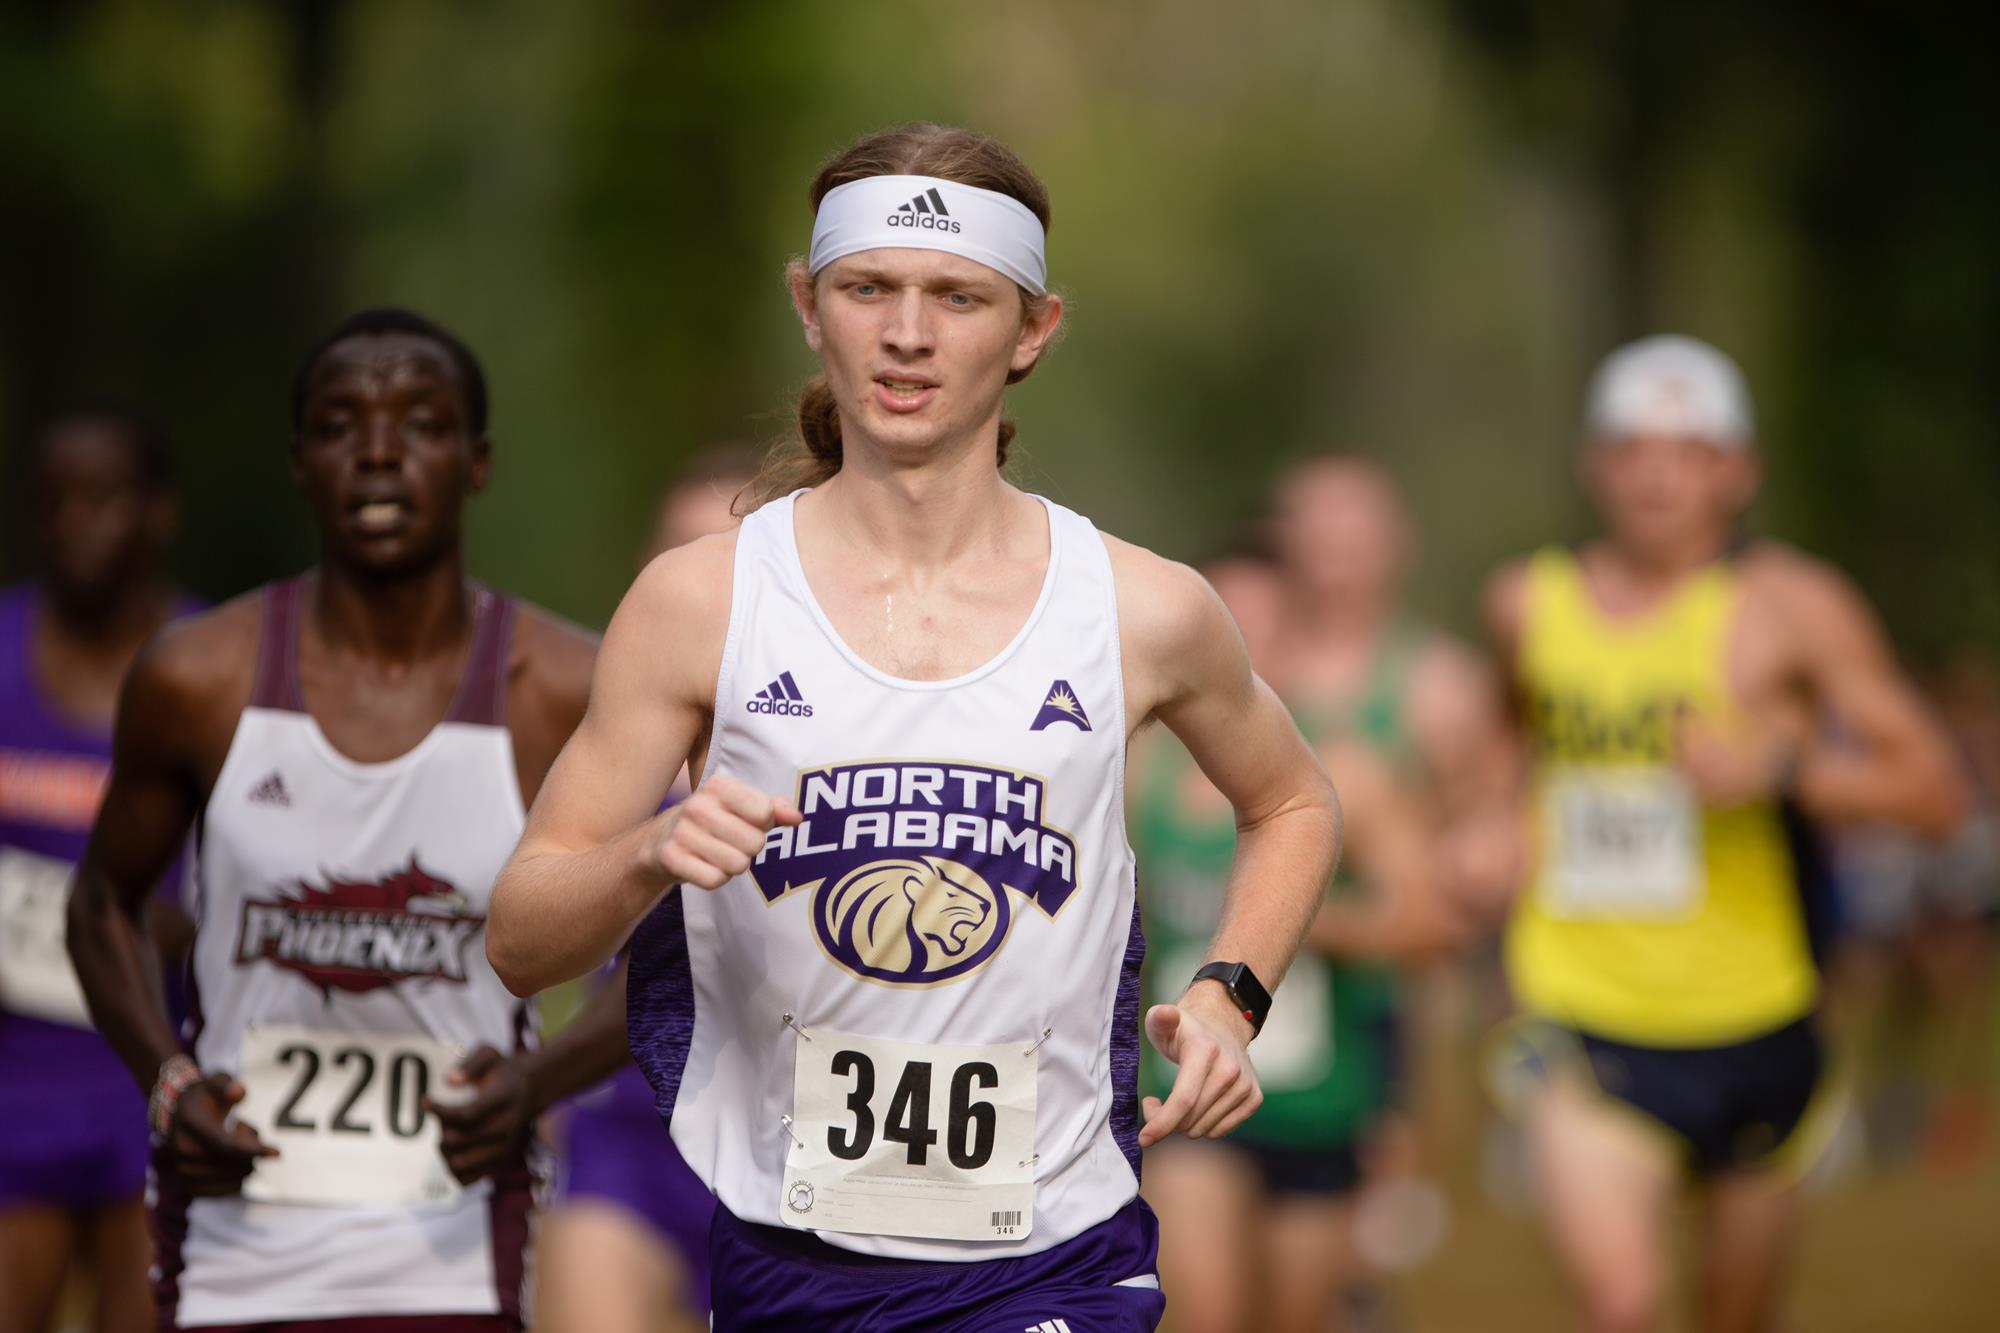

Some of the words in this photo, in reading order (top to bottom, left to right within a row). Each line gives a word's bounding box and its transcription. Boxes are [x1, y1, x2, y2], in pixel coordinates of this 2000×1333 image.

[887, 211, 961, 233] adidas
[746, 698, 813, 717] adidas
[804, 767, 1038, 821] NORTH
[755, 811, 1072, 882] ALABAMA
[240, 905, 474, 978] PHOENIX
[274, 1044, 430, 1137] 220
[827, 1050, 998, 1169] 346
[996, 1226, 1014, 1234] 346
